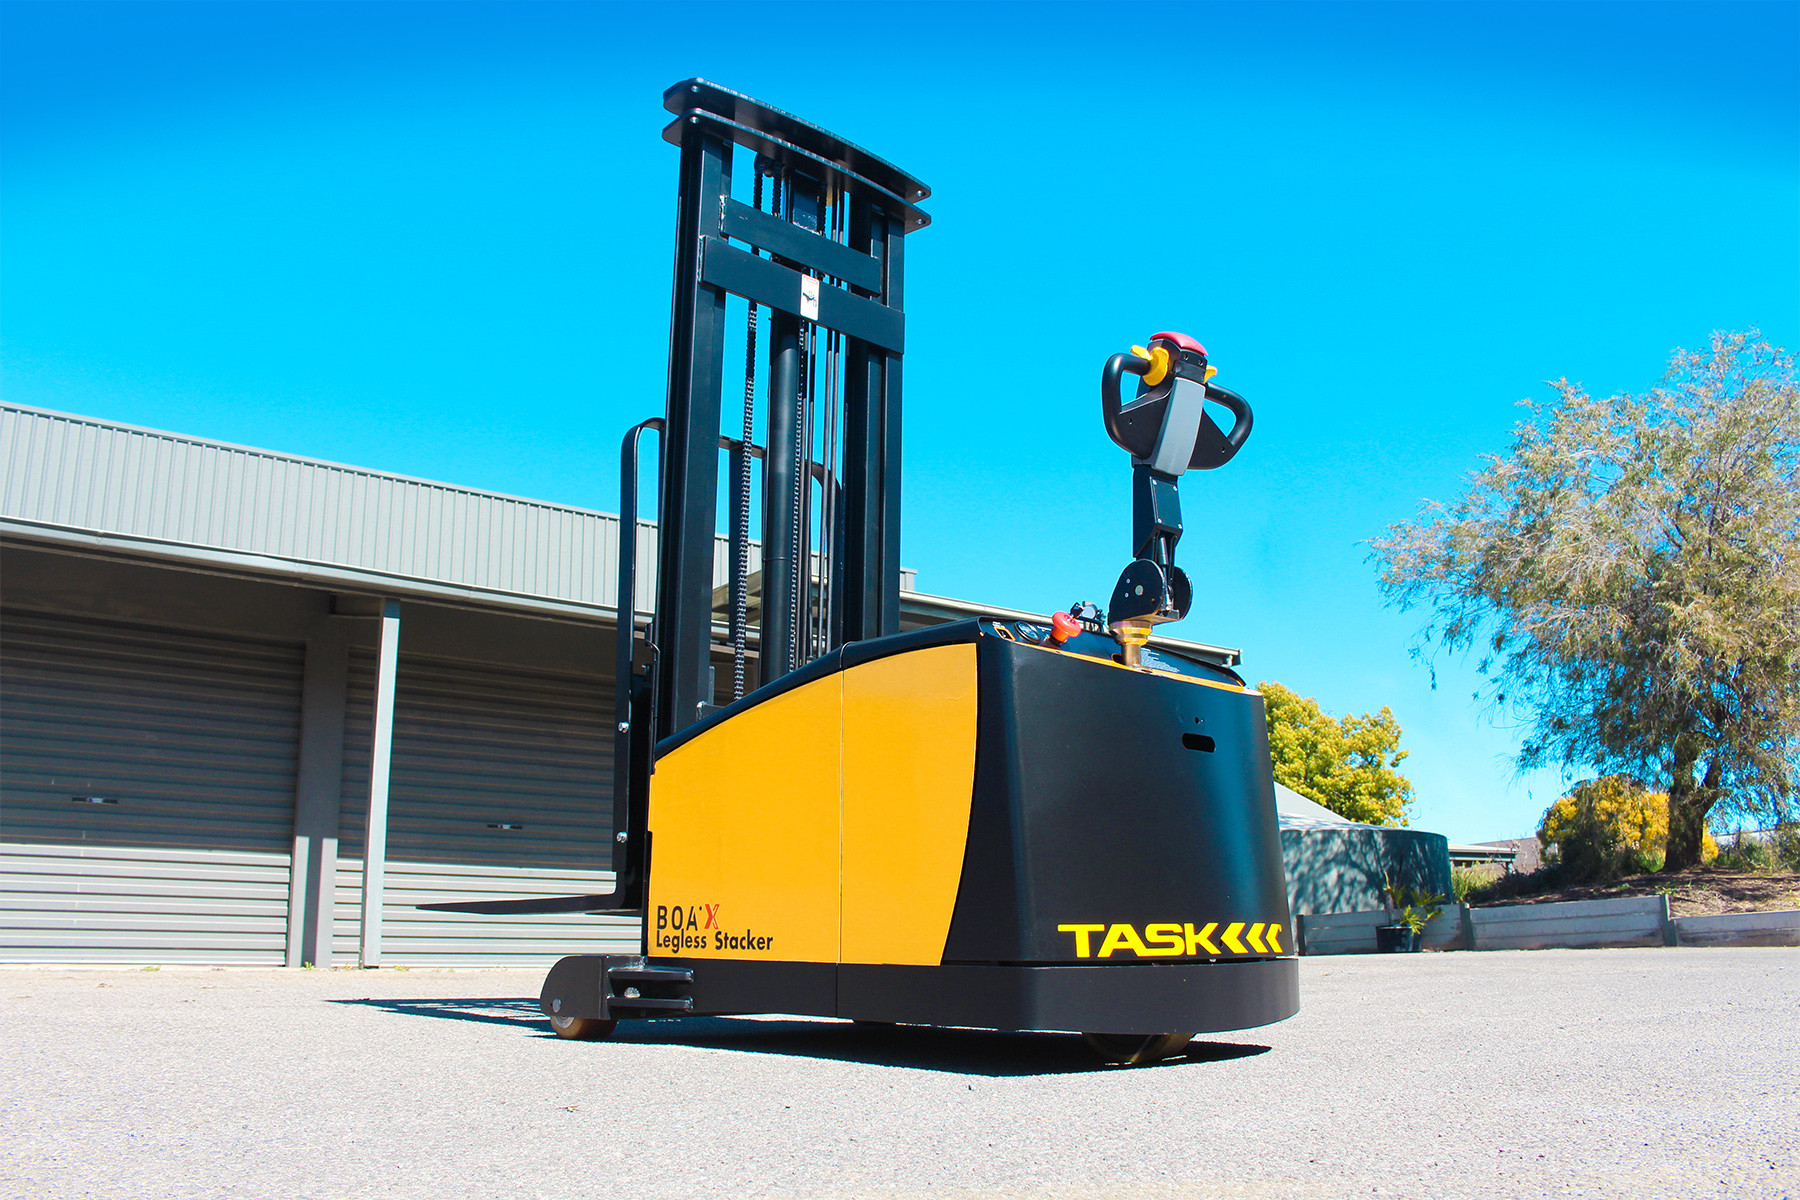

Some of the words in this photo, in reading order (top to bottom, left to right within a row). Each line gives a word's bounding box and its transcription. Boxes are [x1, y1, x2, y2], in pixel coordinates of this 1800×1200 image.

[656, 928, 707, 954] Legless
[715, 929, 773, 950] Stacker
[1057, 922, 1222, 958] TASK
